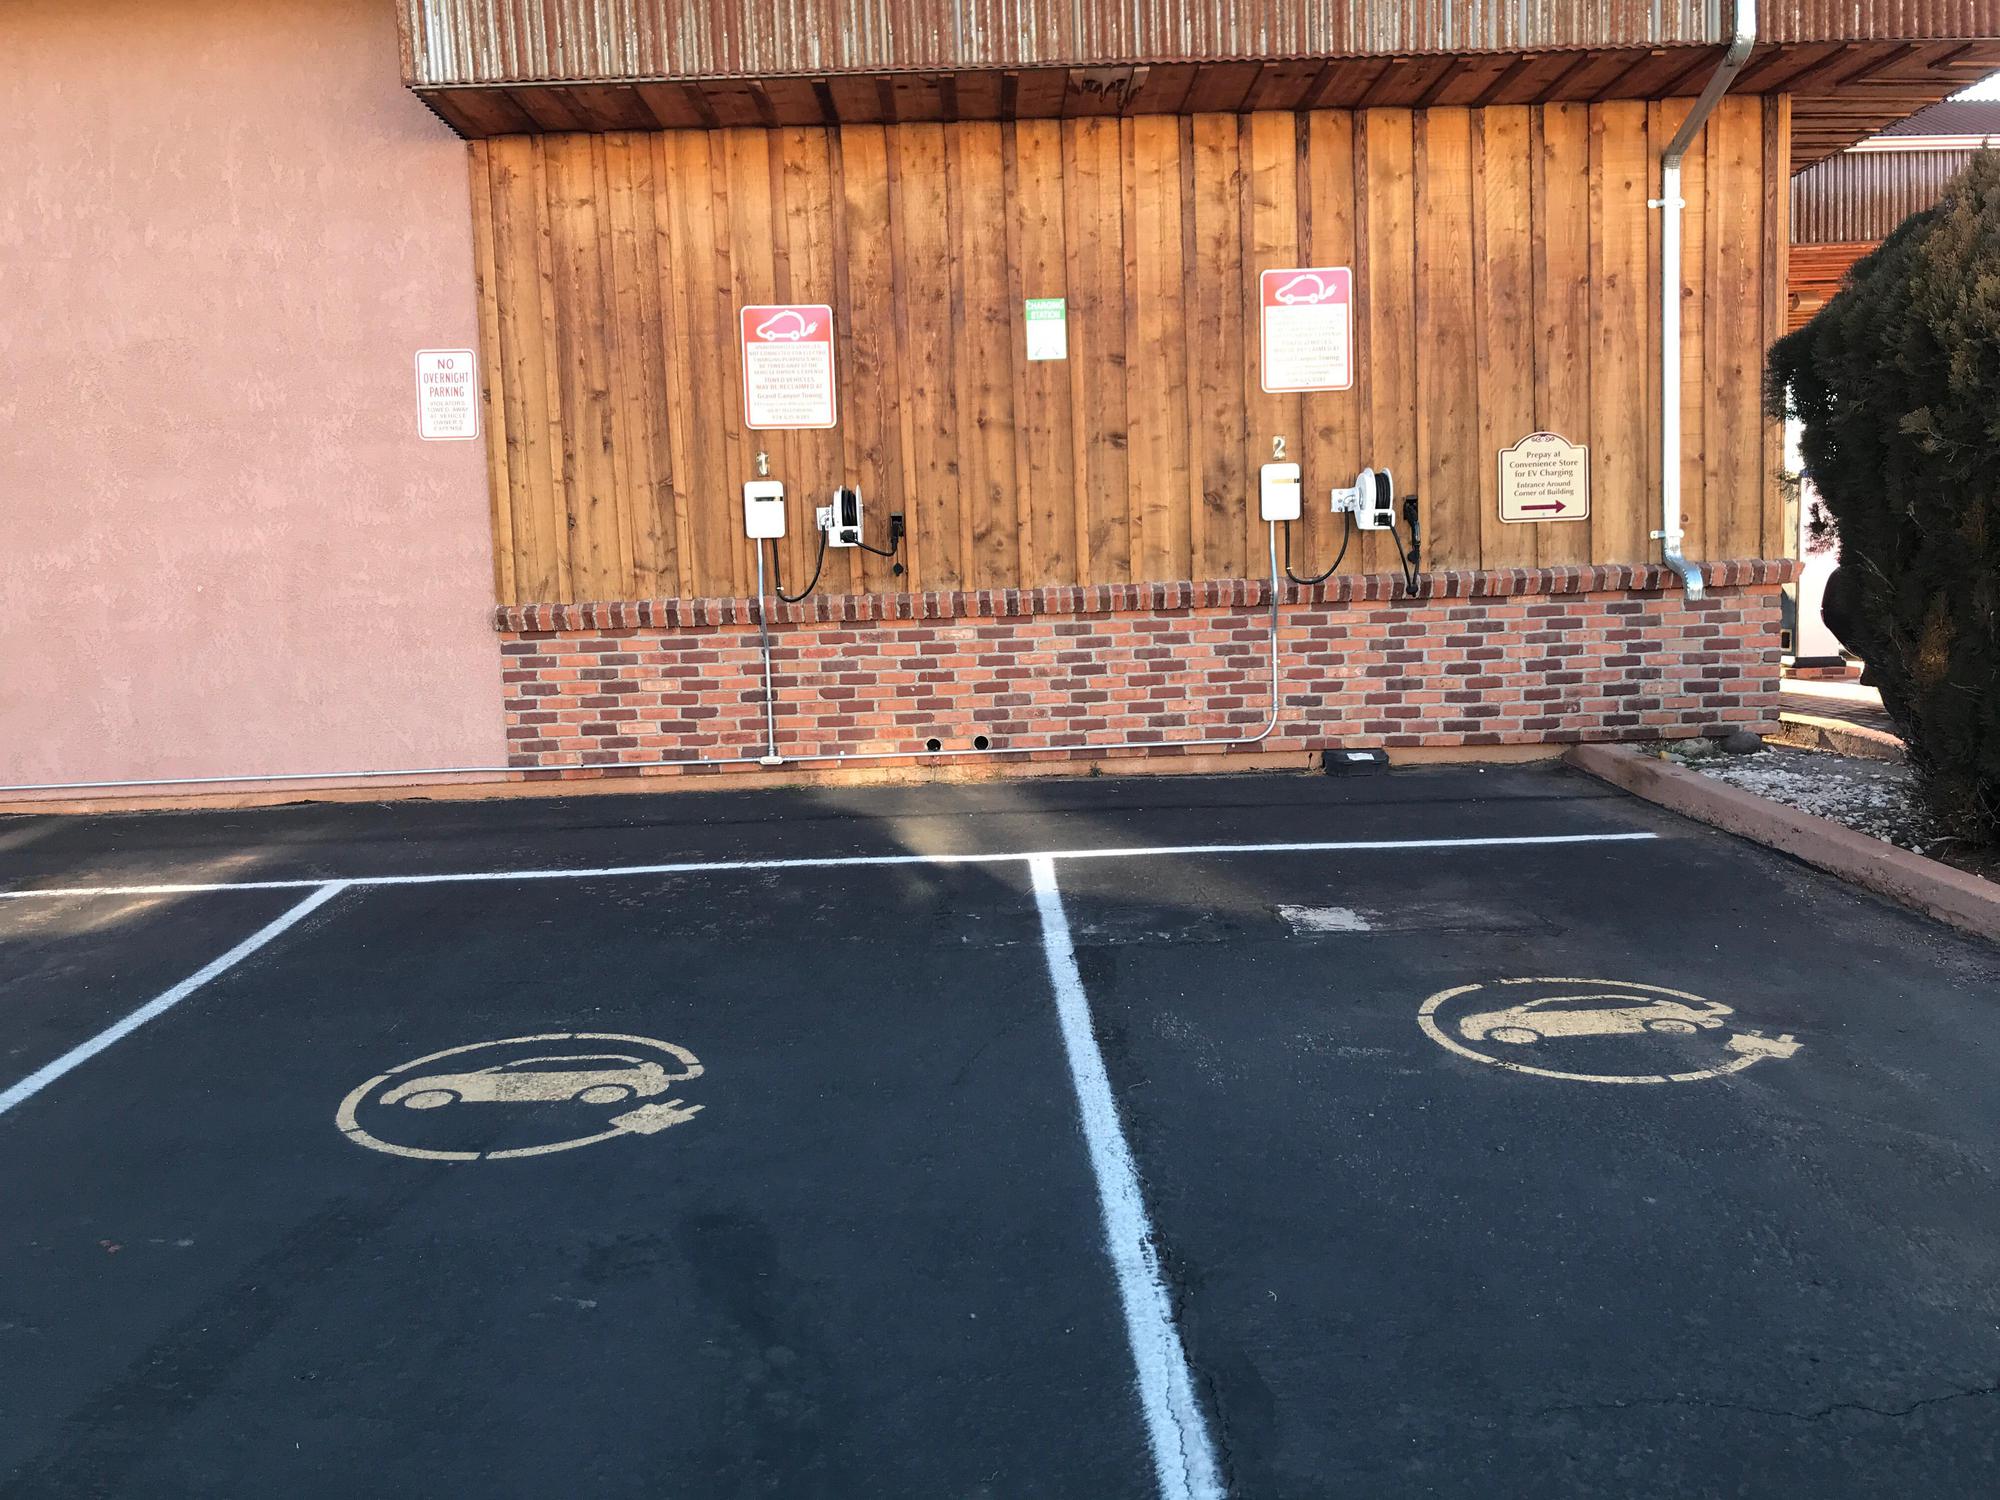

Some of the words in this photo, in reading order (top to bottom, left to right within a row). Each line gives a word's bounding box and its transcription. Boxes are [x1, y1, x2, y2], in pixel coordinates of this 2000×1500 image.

[1030, 310, 1061, 319] STATION
[438, 359, 454, 369] NO
[423, 372, 469, 383] OVERNIGHT
[430, 386, 464, 397] PARKING
[1273, 435, 1286, 459] 2
[1527, 452, 1551, 460] Prepay
[756, 451, 769, 475] 1
[1509, 460, 1557, 468] Convenience
[1539, 469, 1573, 478] Charging
[1547, 488, 1574, 496] Building
